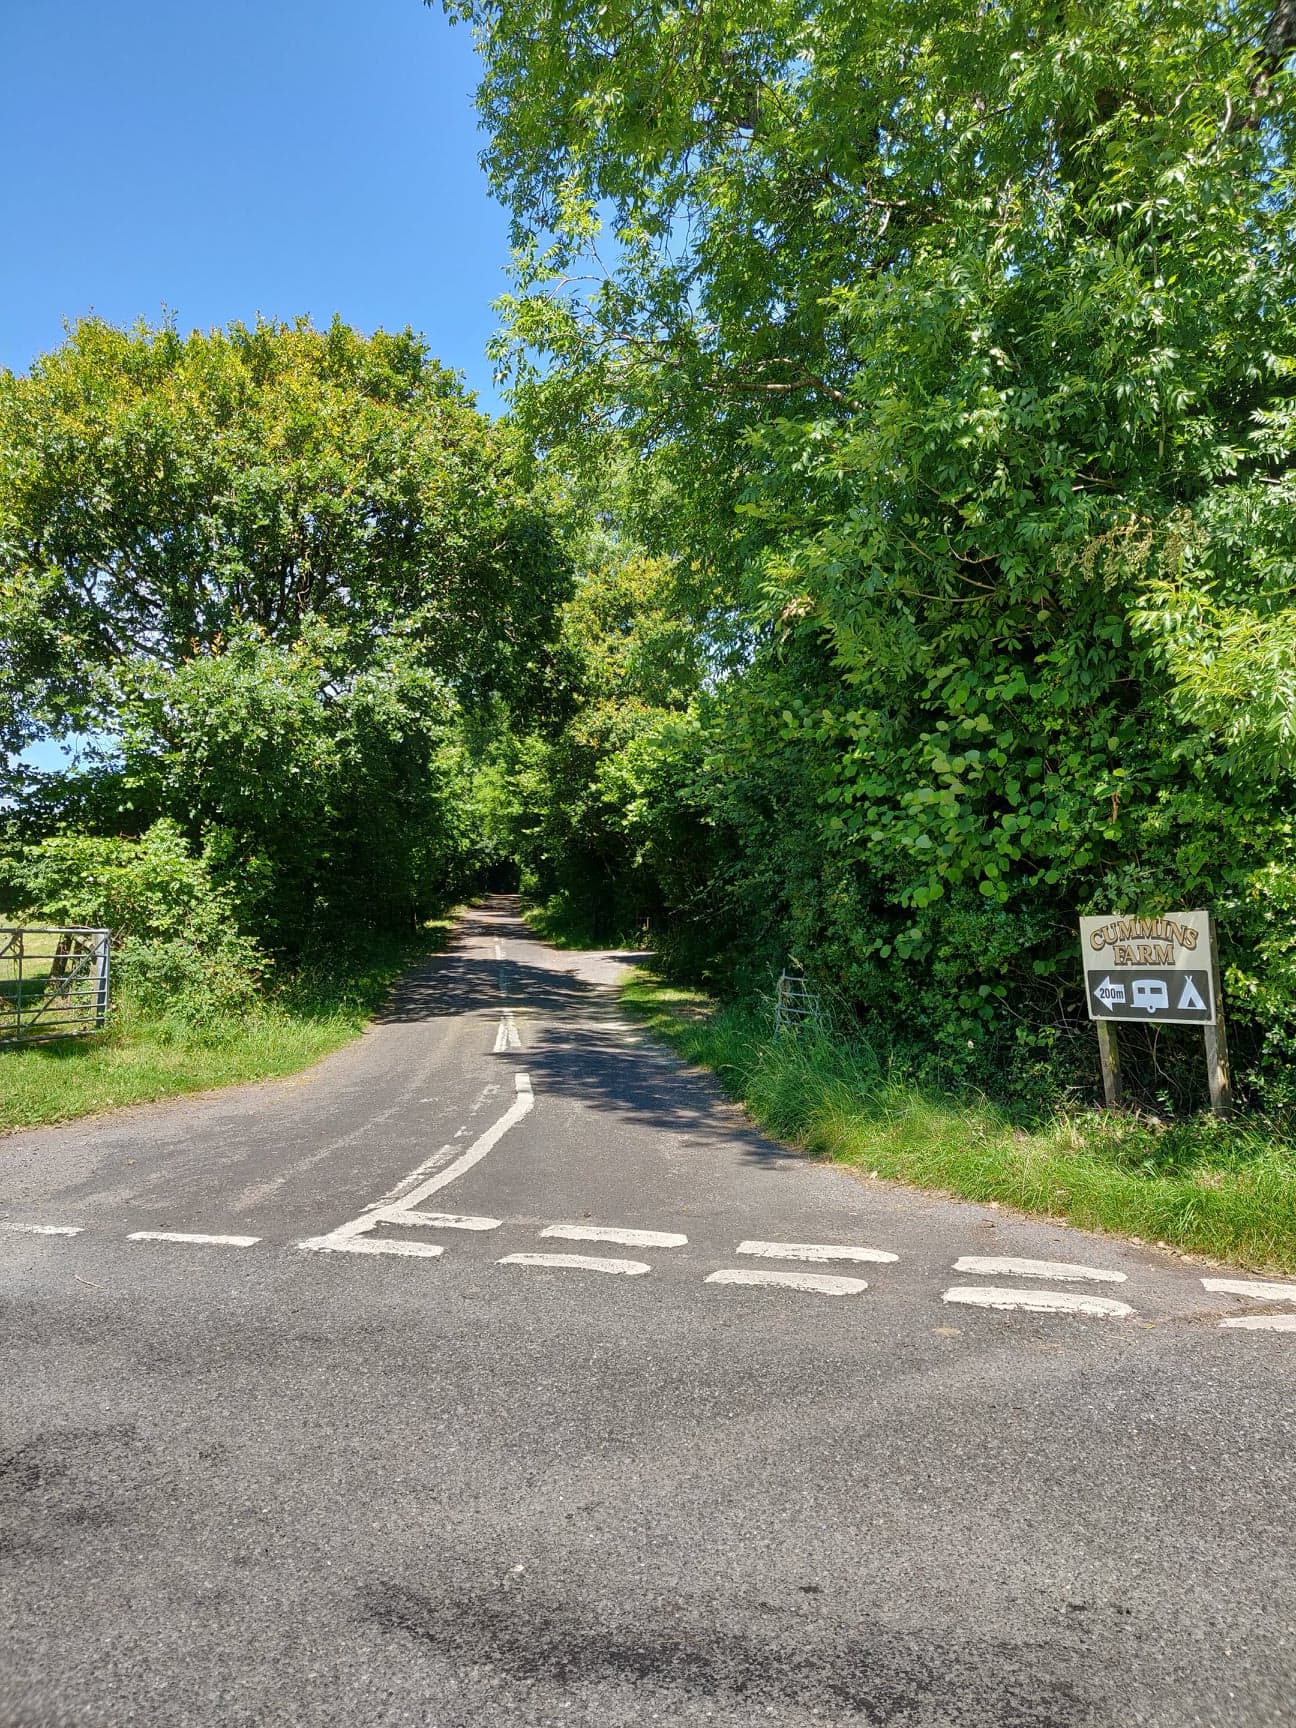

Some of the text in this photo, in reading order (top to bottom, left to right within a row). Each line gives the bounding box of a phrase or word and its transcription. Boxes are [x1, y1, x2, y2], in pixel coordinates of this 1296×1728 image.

[1089, 918, 1199, 951] CUMMINS
[1112, 944, 1176, 966] FARM
[1099, 987, 1124, 1000] 200m
